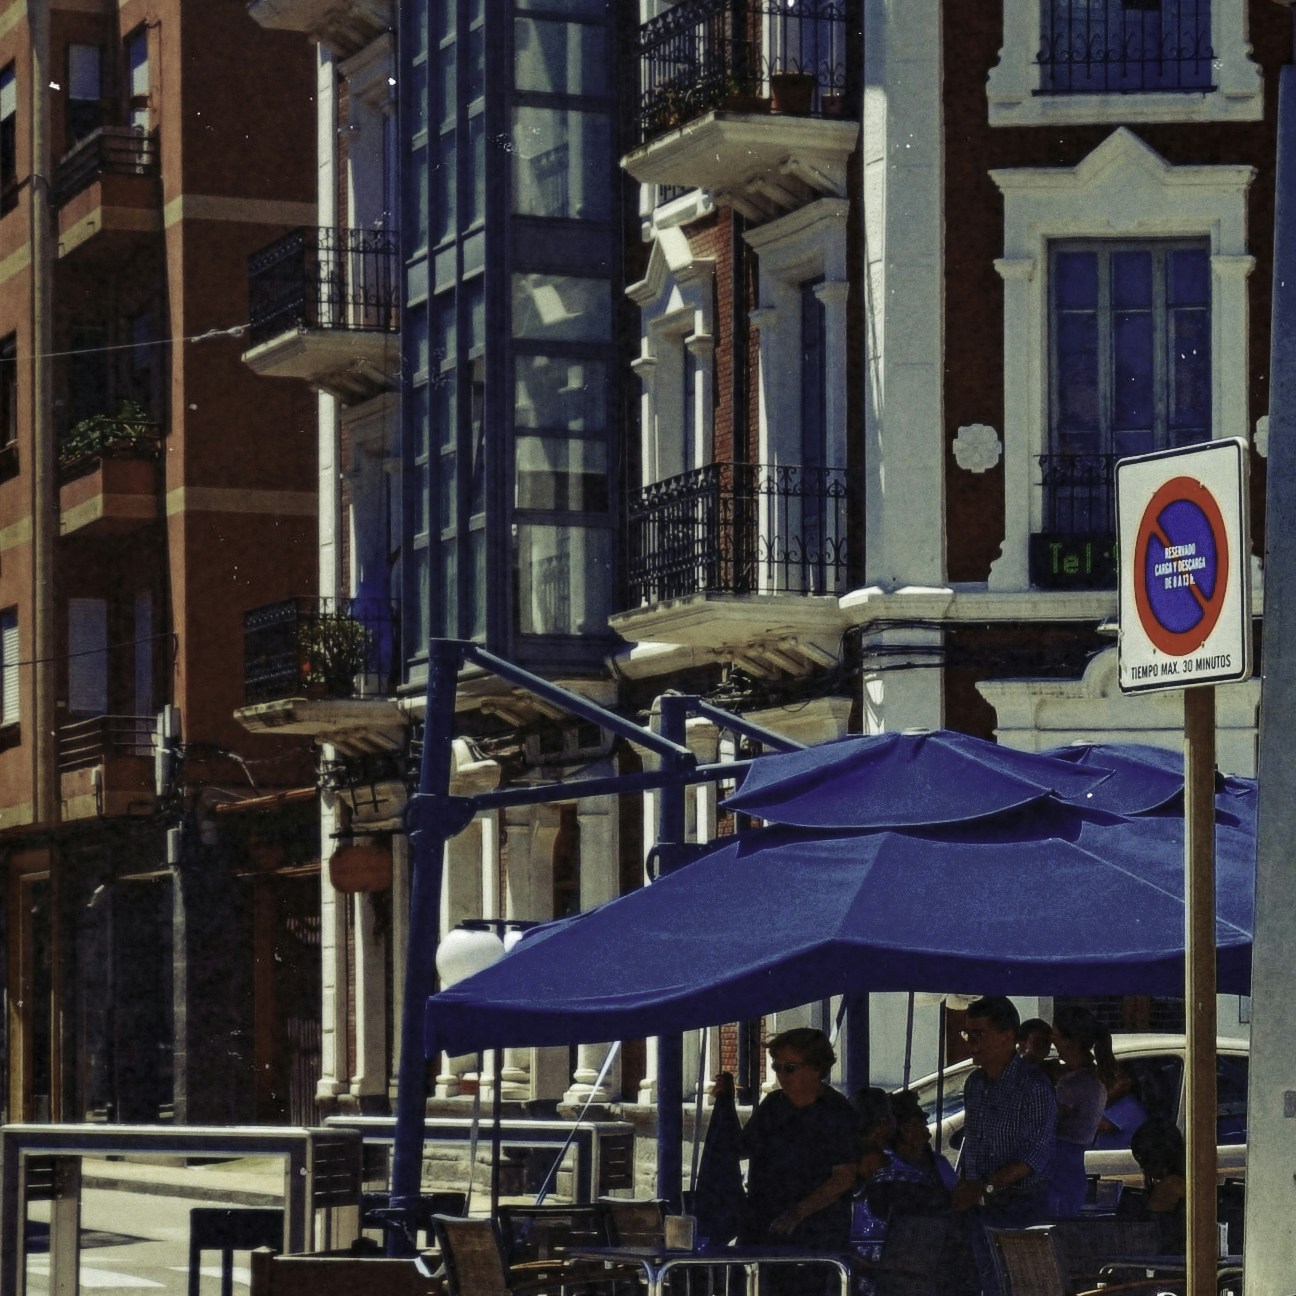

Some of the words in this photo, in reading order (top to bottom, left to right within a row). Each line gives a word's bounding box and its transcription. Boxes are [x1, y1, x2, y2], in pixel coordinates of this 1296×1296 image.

[1164, 543, 1196, 559] RESERVADO
[1155, 562, 1172, 577] CARGA
[1173, 562, 1178, 573] Y
[1178, 556, 1206, 572] DESCARGA
[1165, 576, 1172, 589] DE
[1178, 575, 1182, 587] A
[1131, 664, 1159, 680] TIEMPO
[1161, 661, 1180, 676] MAX.
[1183, 659, 1193, 673] 30
[1196, 654, 1232, 672] MINUTOS
